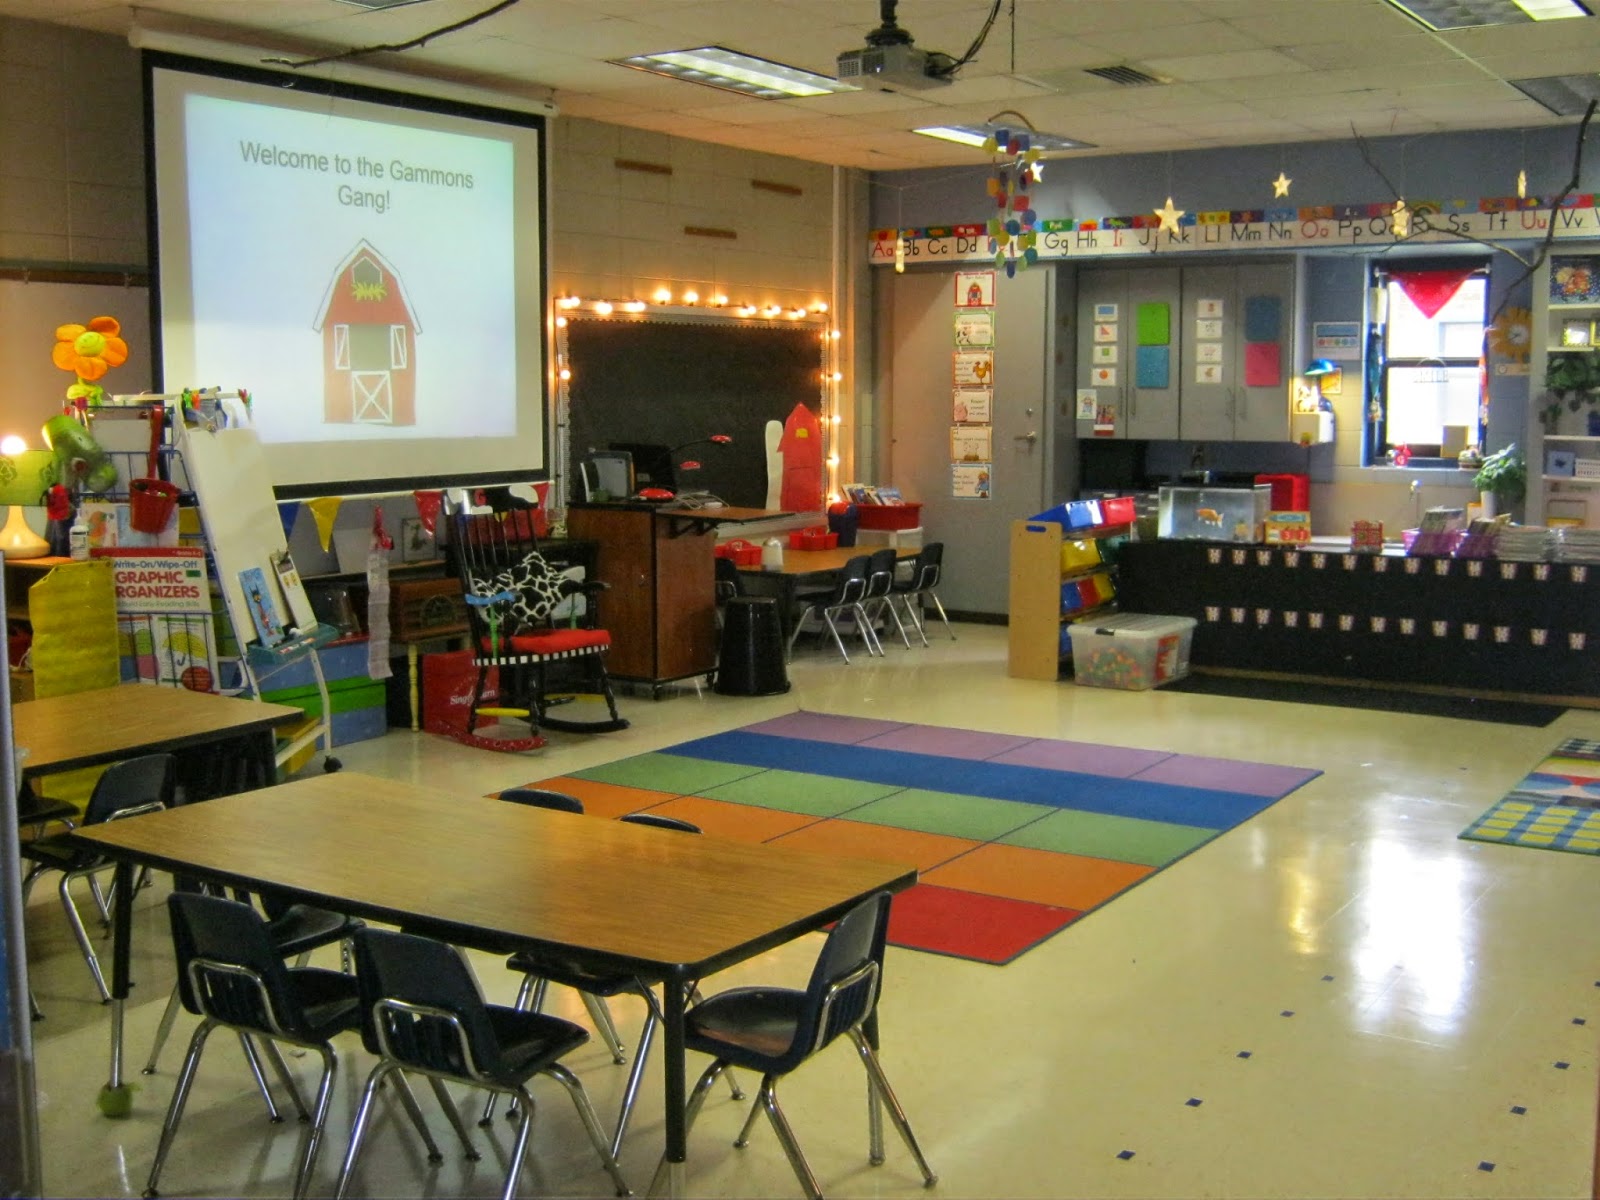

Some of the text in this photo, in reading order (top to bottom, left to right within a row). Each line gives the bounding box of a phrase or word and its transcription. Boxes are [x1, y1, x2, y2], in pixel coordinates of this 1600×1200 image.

[239, 140, 474, 189] Welcome to the Gammons
[337, 185, 391, 214] Gang!
[872, 242, 894, 257] Aa
[927, 238, 948, 255] Cc
[956, 237, 977, 254] Dd
[1044, 232, 1069, 256] Gg
[1077, 230, 1098, 248] Hh
[1139, 228, 1159, 253] Jj
[1230, 223, 1261, 241] Mm
[1268, 222, 1293, 240] Nn
[1301, 220, 1328, 238] Oo
[1338, 219, 1363, 244] Pp
[1449, 213, 1470, 232] Ss
[1488, 212, 1508, 231] Tt
[1521, 211, 1547, 231] Uu
[1561, 209, 1583, 229] Vv
[115, 571, 184, 583] GRAPHIC
[115, 586, 201, 598] RGANIZERS
